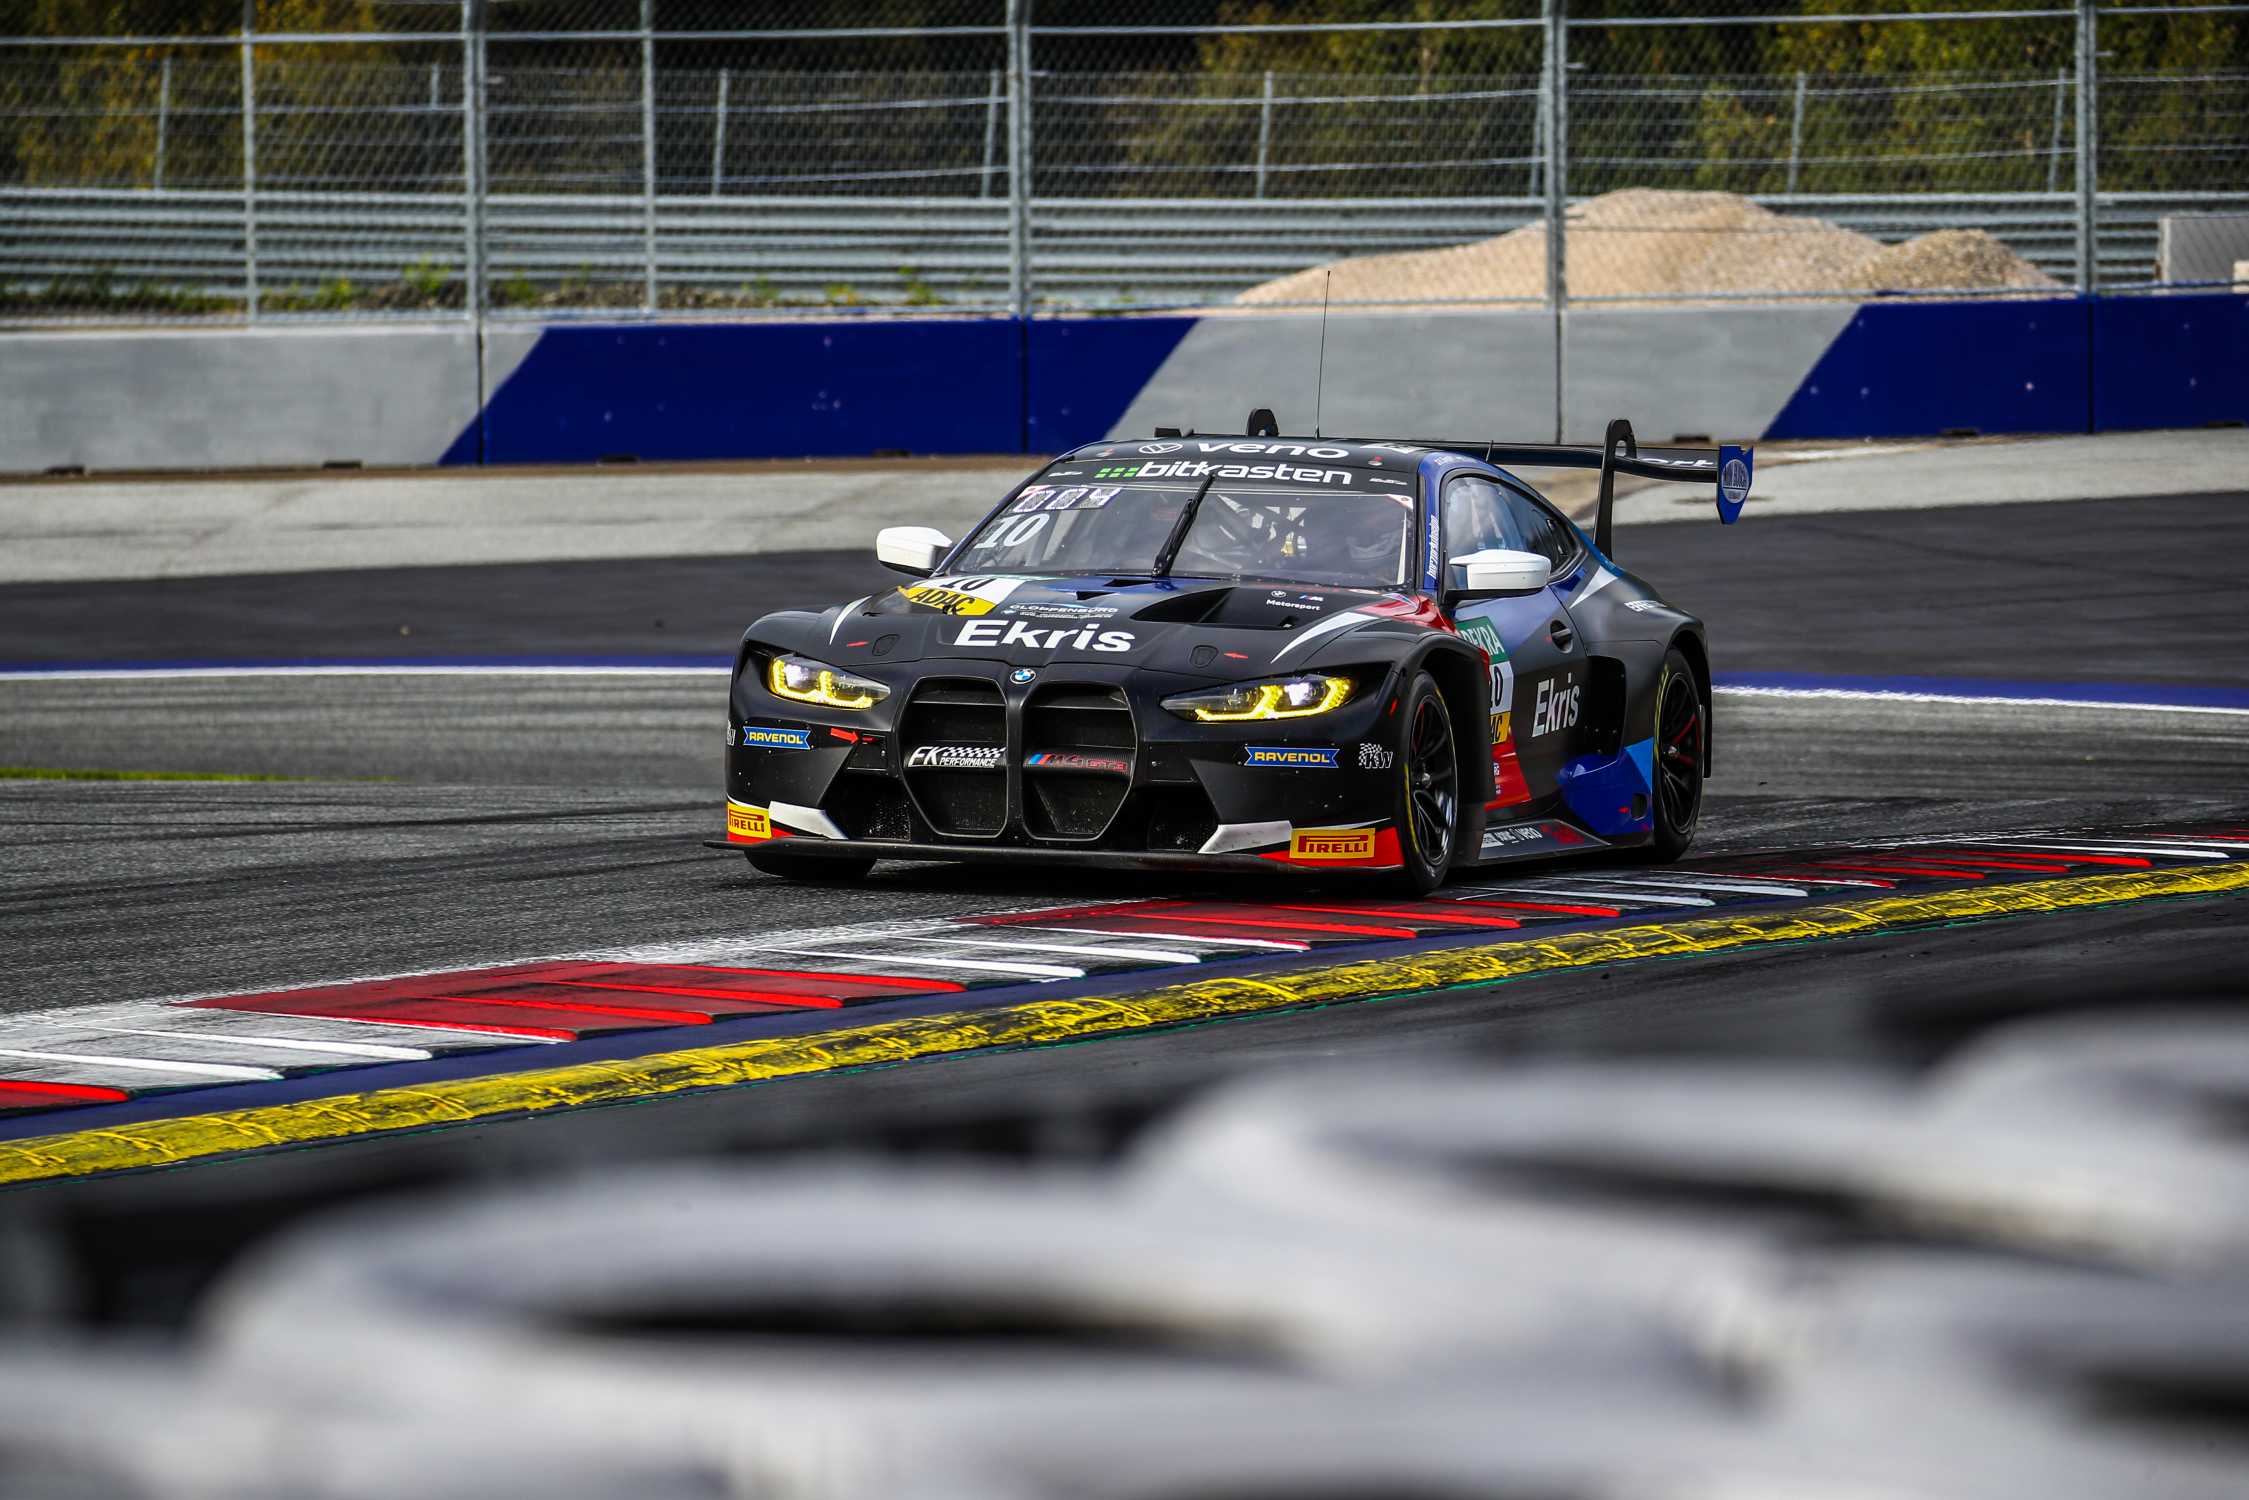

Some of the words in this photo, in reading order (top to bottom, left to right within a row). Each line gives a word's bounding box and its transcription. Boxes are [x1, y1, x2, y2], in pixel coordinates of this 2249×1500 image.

[1199, 443, 1350, 459] veno
[1136, 460, 1352, 485] bitkasten
[973, 513, 1050, 549] 10
[939, 577, 998, 592] 10
[911, 588, 976, 614] ADAC
[1266, 599, 1321, 611] Motorsport
[953, 619, 1136, 652] Ekris
[1532, 672, 1580, 738] Ekris
[749, 731, 804, 744] RAVENOL
[908, 746, 948, 767] FK
[939, 757, 997, 768] PERFORMANCE
[1254, 751, 1330, 763] RAVENOL
[1363, 750, 1394, 769] KW
[729, 809, 765, 832] PIRELLI
[1298, 834, 1369, 853] PIRELLI
